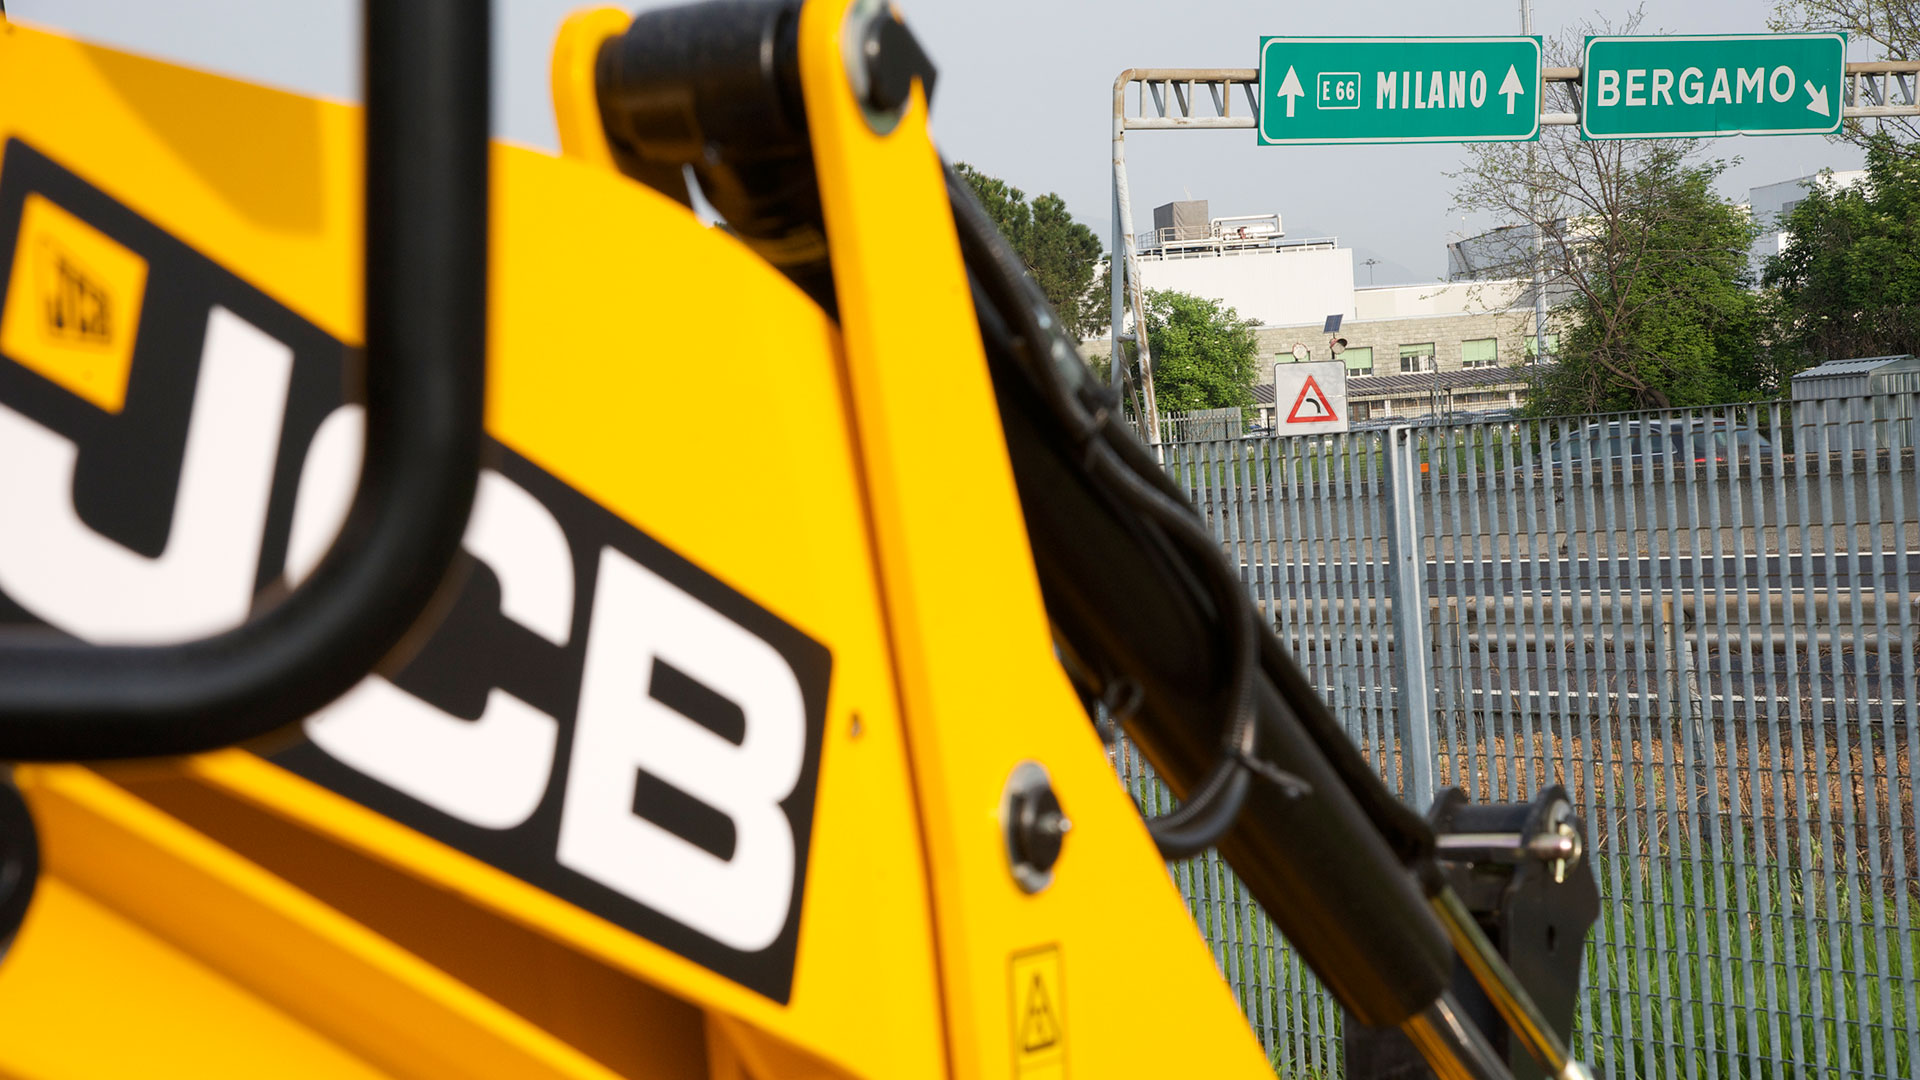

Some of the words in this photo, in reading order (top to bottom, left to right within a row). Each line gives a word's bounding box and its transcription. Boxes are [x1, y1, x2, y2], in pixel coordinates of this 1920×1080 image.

[1322, 80, 1331, 101] E
[1335, 80, 1355, 101] 66
[1376, 69, 1487, 109] MILANO
[1597, 65, 1796, 107] BERGAMO
[0, 306, 806, 952] JCB
